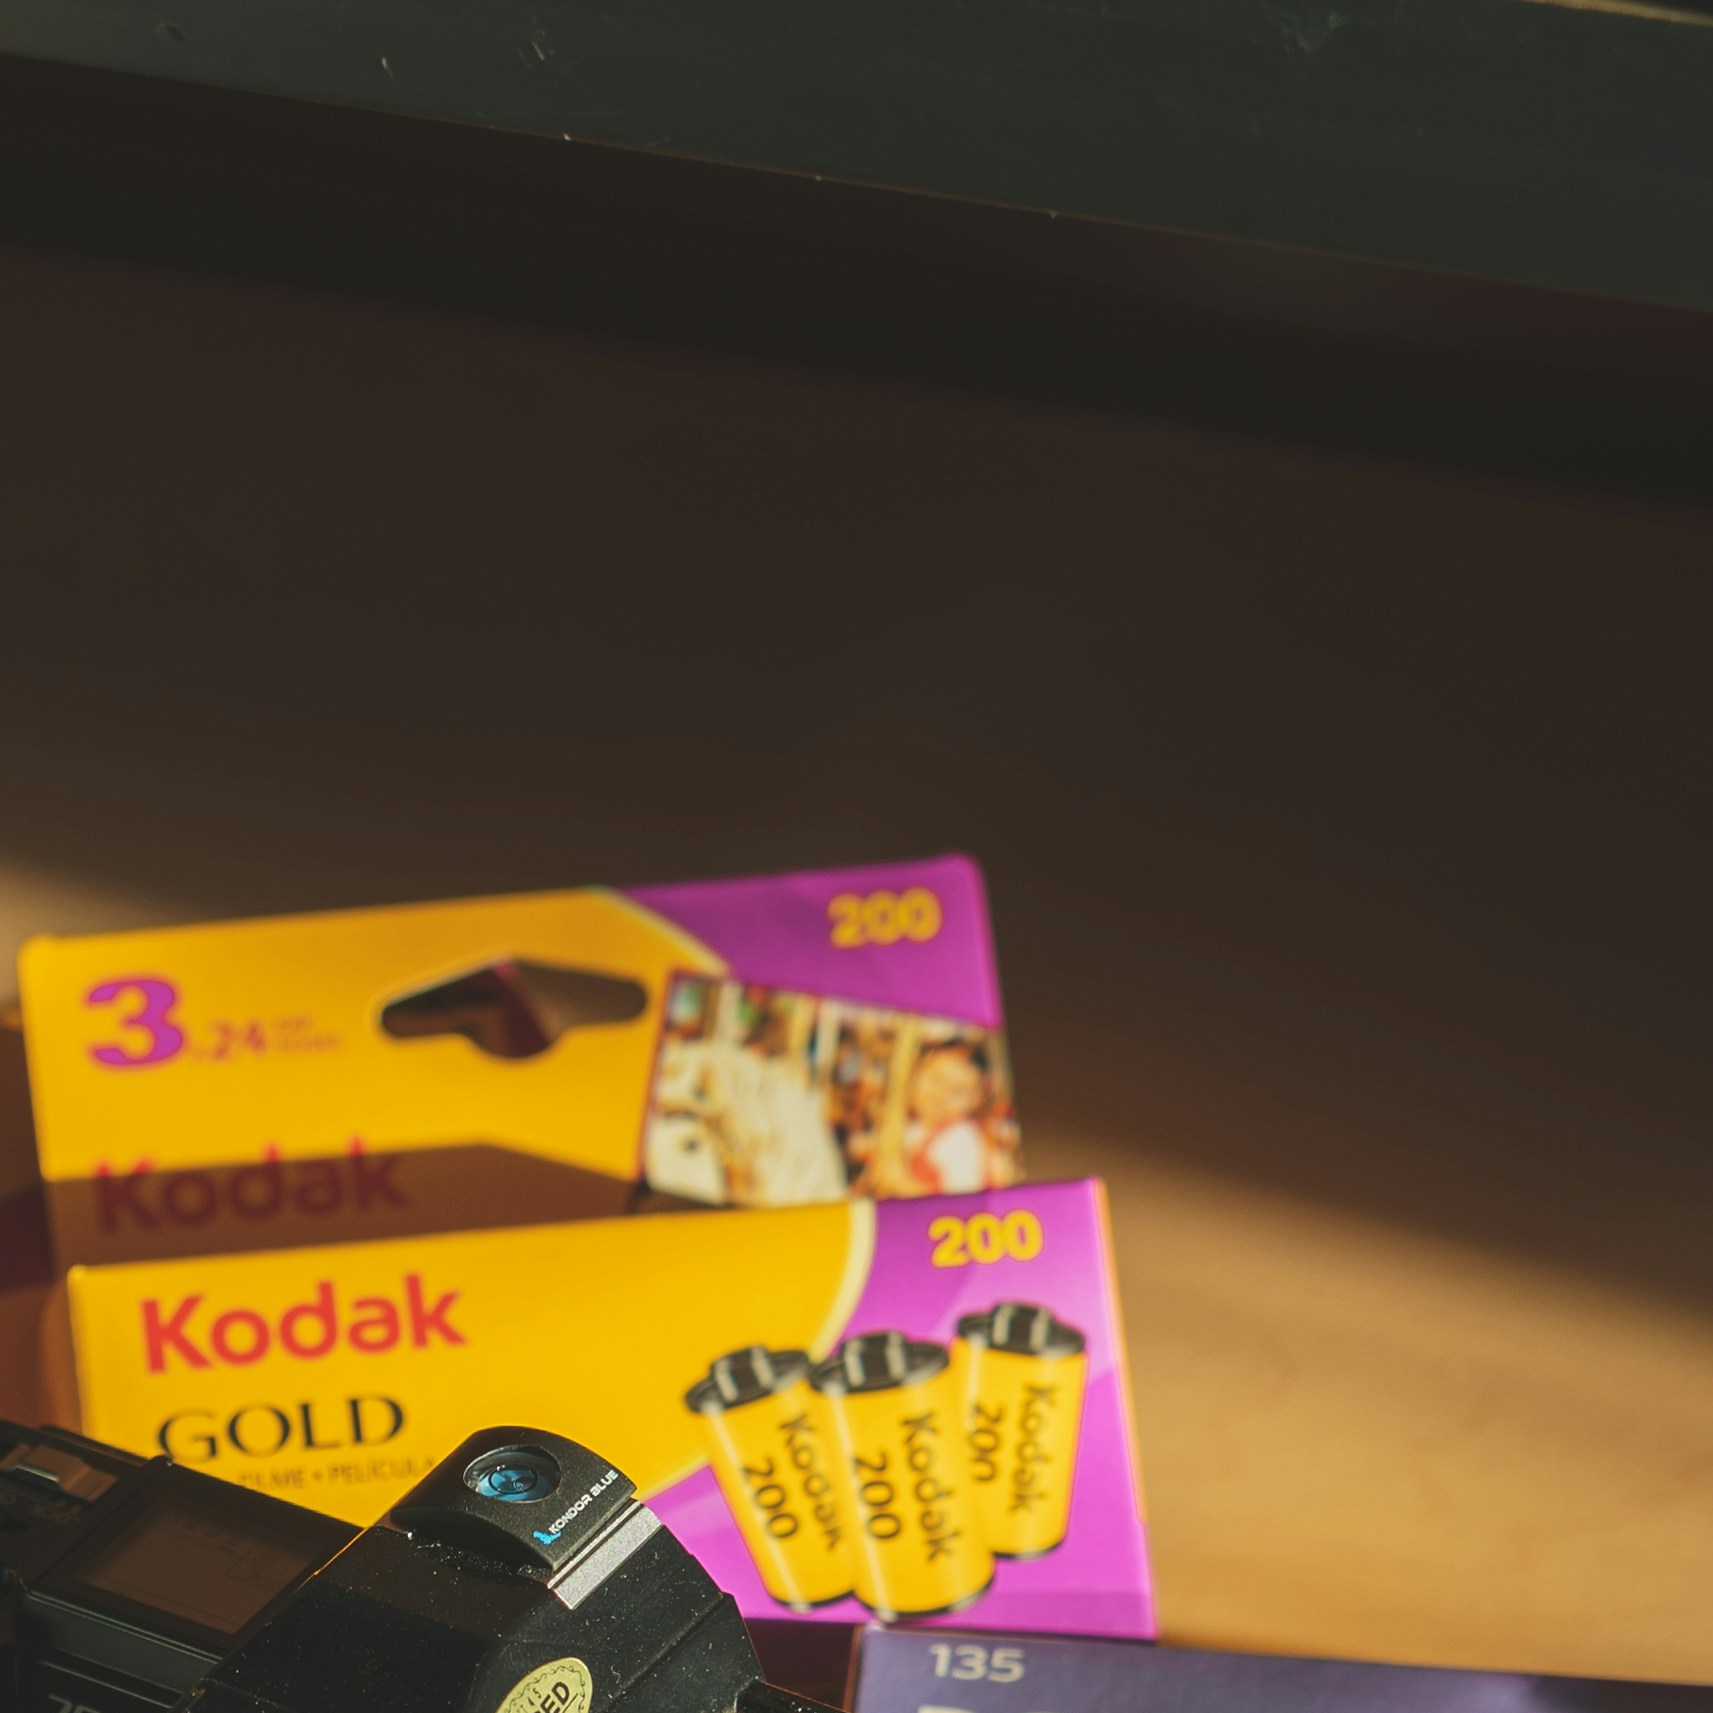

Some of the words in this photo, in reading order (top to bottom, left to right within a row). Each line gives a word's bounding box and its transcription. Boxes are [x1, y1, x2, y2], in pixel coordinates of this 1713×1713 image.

[829, 887, 941, 948] 200
[85, 976, 185, 1070] 3
[93, 1135, 412, 1234] Kodak
[929, 1209, 1043, 1268] 200
[141, 1272, 468, 1375] Kodak
[157, 1394, 406, 1464] GOLD
[1010, 1384, 1058, 1515] Kodak
[549, 1493, 593, 1536] KONDOR
[589, 1468, 619, 1500] BLUE
[743, 1457, 799, 1543] 200
[779, 1412, 844, 1551] Kodak
[854, 1452, 900, 1543] 200
[902, 1412, 958, 1562] Kodak
[929, 1643, 1026, 1683] 135
